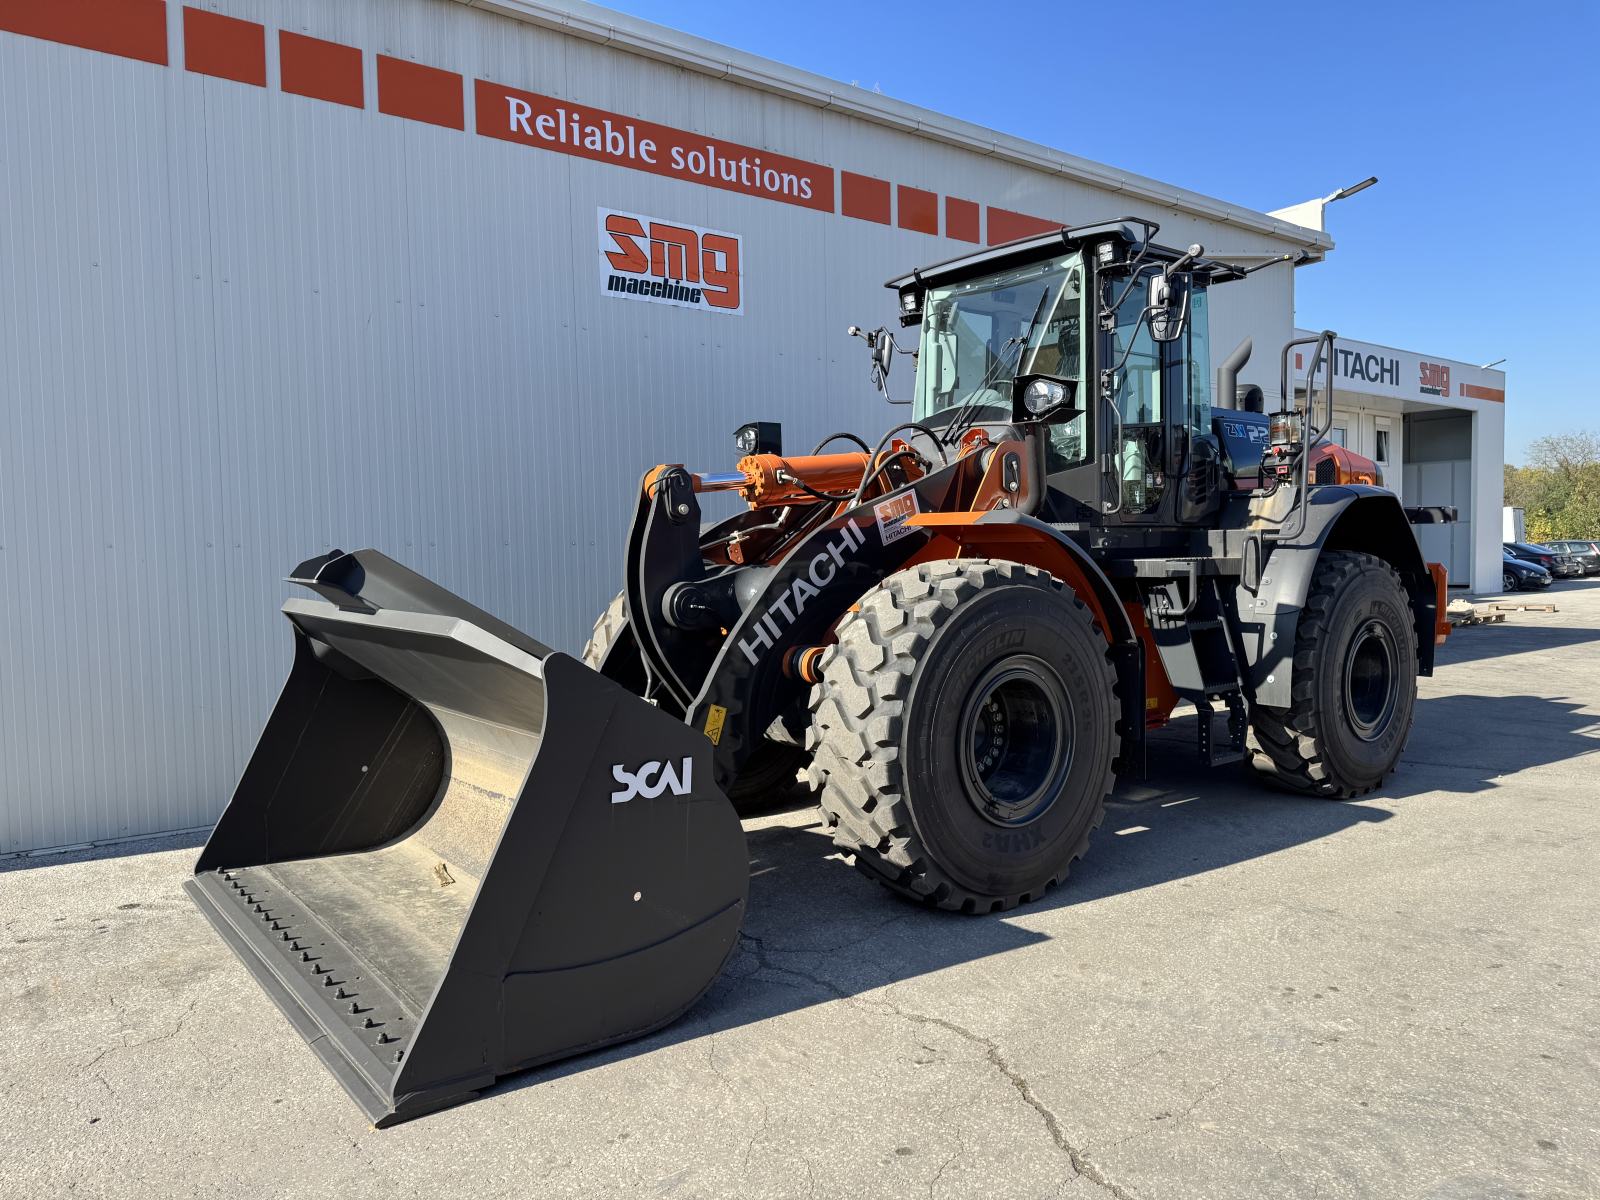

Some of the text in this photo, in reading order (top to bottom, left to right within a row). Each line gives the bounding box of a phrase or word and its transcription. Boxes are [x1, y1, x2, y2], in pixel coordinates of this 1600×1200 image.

[505, 96, 813, 200] Reliable solutions
[604, 214, 741, 310] smg
[607, 274, 702, 304] macchine
[1246, 425, 1270, 444] 22
[885, 524, 912, 541] HITACHI
[738, 518, 867, 666] HITACHI
[611, 757, 692, 803] SCAI
